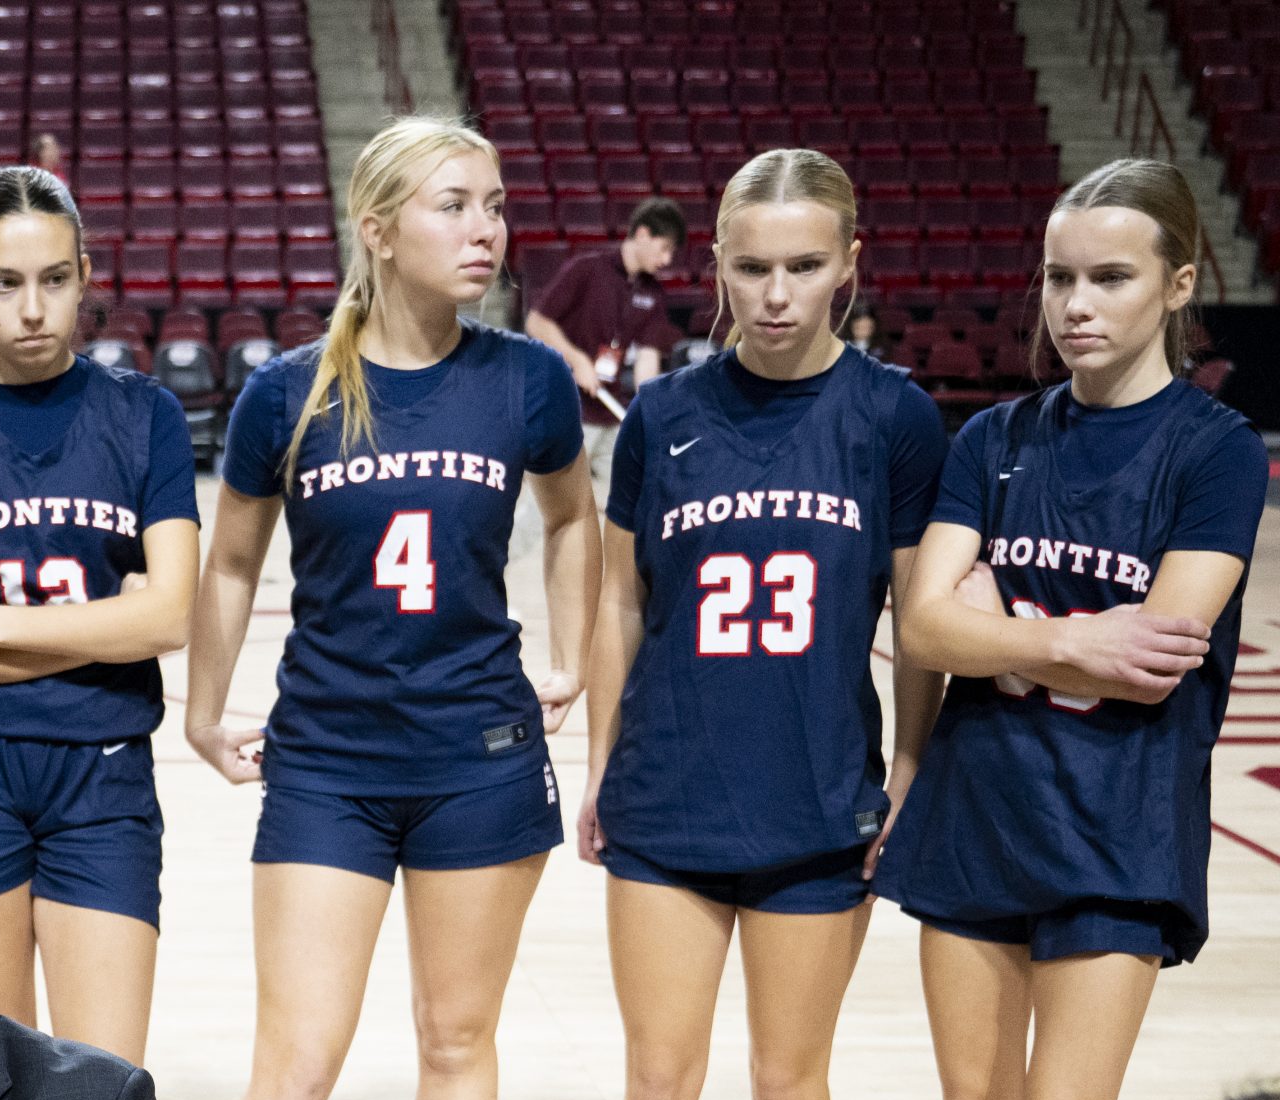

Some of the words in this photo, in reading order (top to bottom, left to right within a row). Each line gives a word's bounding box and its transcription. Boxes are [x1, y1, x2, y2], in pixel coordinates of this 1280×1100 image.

[300, 450, 507, 499] FRONTIER
[661, 490, 862, 540] FRONTIER
[373, 509, 436, 614] 4
[988, 537, 1151, 593] RONTIER
[696, 550, 818, 657] 23
